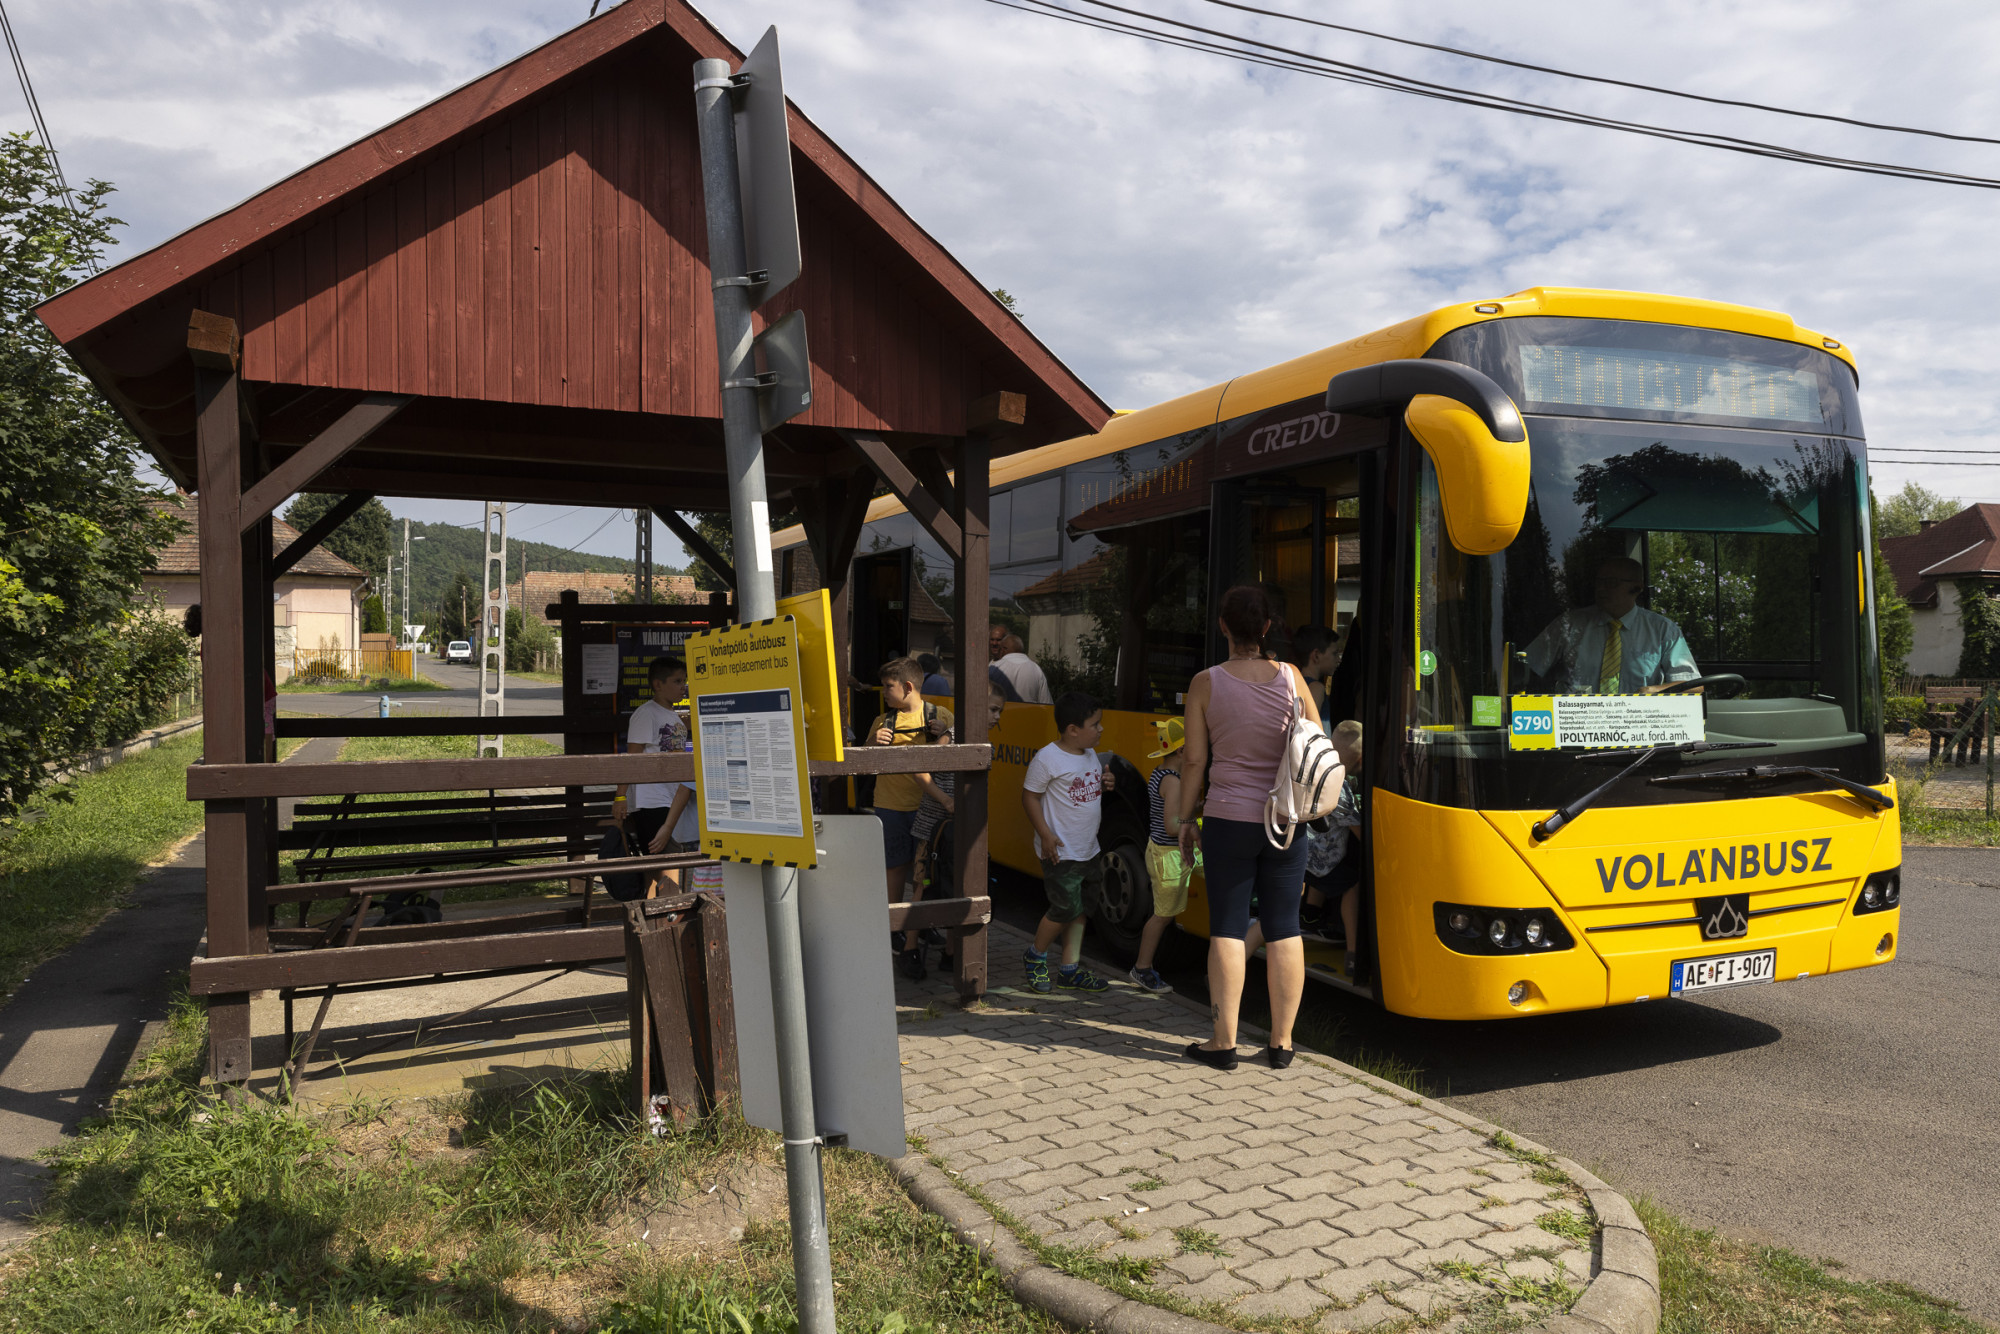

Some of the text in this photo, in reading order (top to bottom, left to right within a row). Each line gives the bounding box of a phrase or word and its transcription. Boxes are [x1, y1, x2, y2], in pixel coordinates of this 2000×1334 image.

[1248, 410, 1341, 456] CREDO
[709, 635, 786, 657] Vonatpótló autóbusz
[711, 655, 788, 676] Train replacement bus
[1558, 701, 1604, 709] Balassagyarmat,
[1514, 714, 1551, 732] S790
[1560, 730, 1690, 743] IPOLYTARNÓC, aut. ford. amh.
[1595, 837, 1832, 893] VOLÁNBUSZ
[1685, 954, 1772, 987] AE FI-907
[1674, 979, 1681, 988] H
